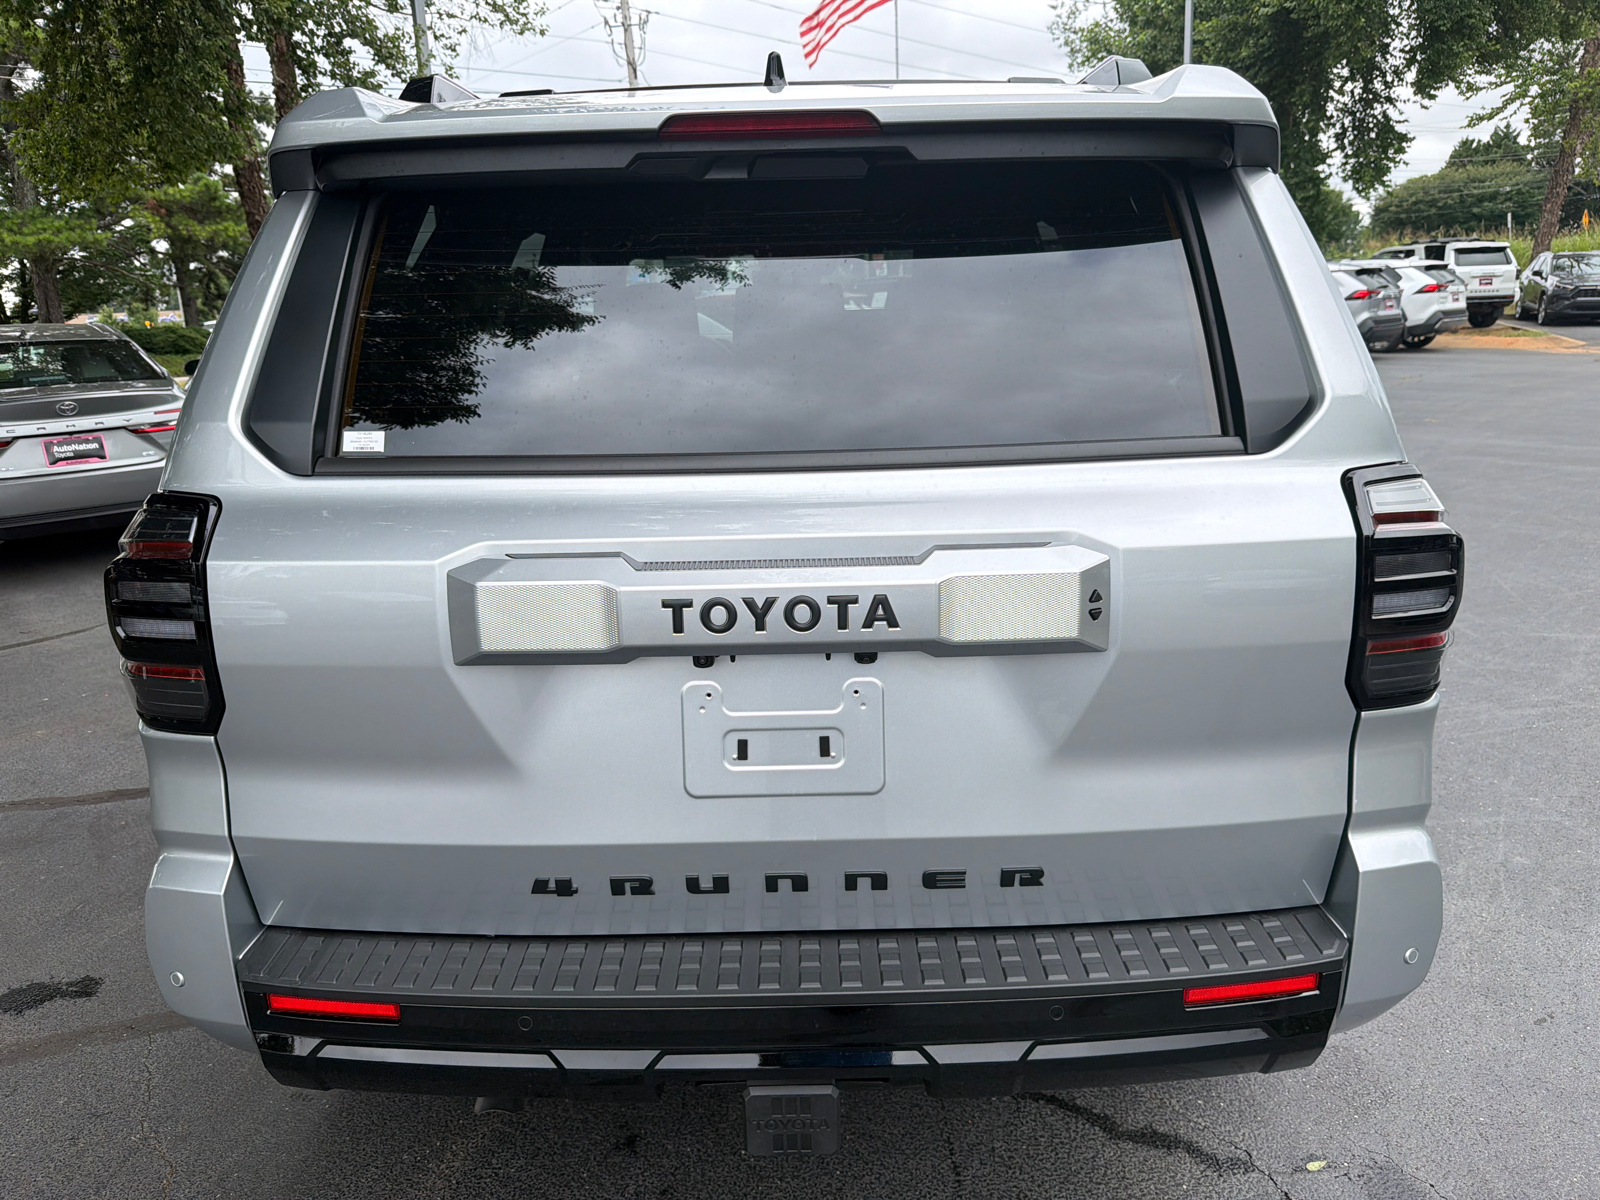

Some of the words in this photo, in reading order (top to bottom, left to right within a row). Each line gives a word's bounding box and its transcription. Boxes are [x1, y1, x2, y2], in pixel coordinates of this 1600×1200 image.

[5, 418, 133, 434] CAMRY
[53, 442, 99, 453] AutoNation
[660, 593, 902, 636] TOYOTA
[530, 865, 1045, 897] 4RUNNER
[752, 1118, 831, 1133] TOYOTA
